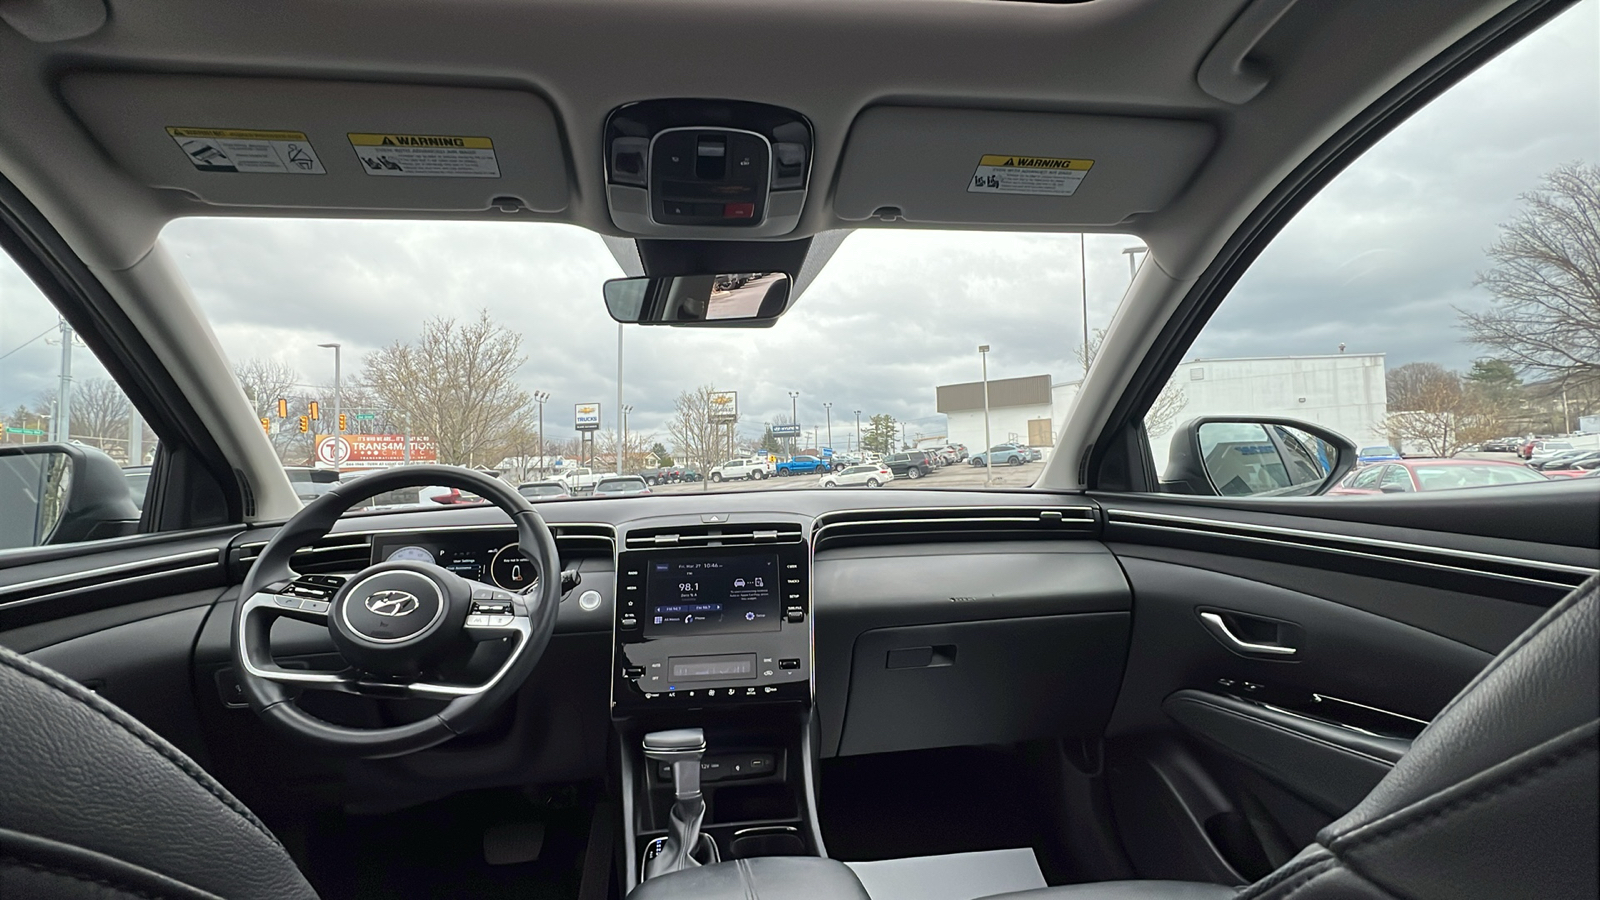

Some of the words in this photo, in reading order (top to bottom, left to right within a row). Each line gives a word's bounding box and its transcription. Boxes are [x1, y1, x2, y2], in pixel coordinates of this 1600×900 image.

[395, 136, 465, 147] WARNING
[1017, 157, 1072, 169] WARNING
[678, 582, 699, 592] 98.1
